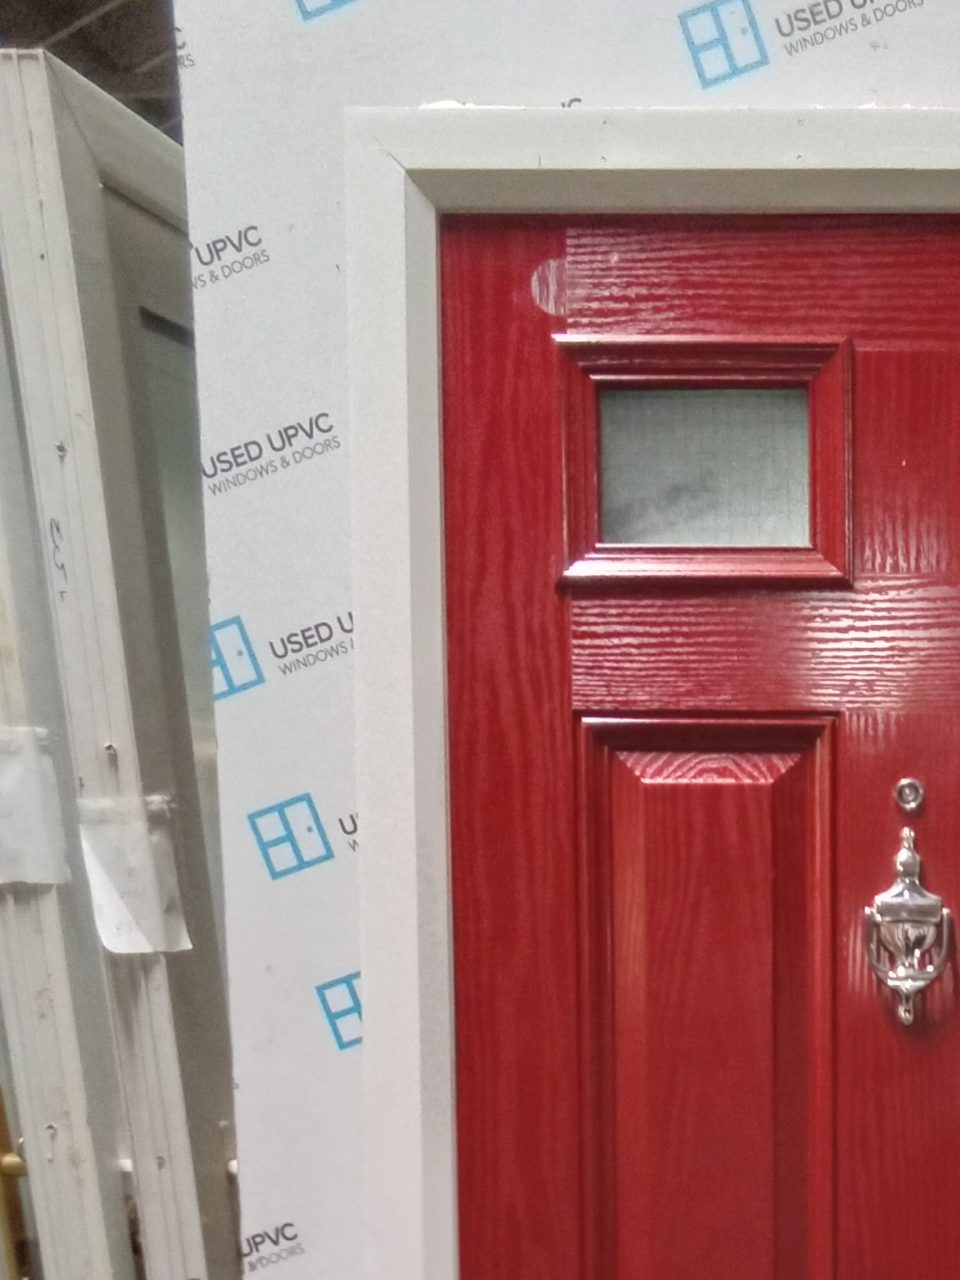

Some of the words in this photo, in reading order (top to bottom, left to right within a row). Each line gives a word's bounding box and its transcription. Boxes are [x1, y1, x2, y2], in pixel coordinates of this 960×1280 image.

[775, 0, 843, 38] USED
[783, 17, 858, 57] WINDOWS
[860, 13, 871, 27] &
[195, 225, 262, 266] UPVC
[221, 249, 270, 281] DOORS
[202, 440, 263, 479] USED
[266, 412, 334, 453] UPVC
[208, 460, 278, 497] WINDOWS
[280, 455, 291, 470] &
[292, 435, 341, 466] DOORS
[269, 621, 333, 660] USED
[277, 640, 349, 676] WINDOWS
[256, 1243, 305, 1269] DOORS
